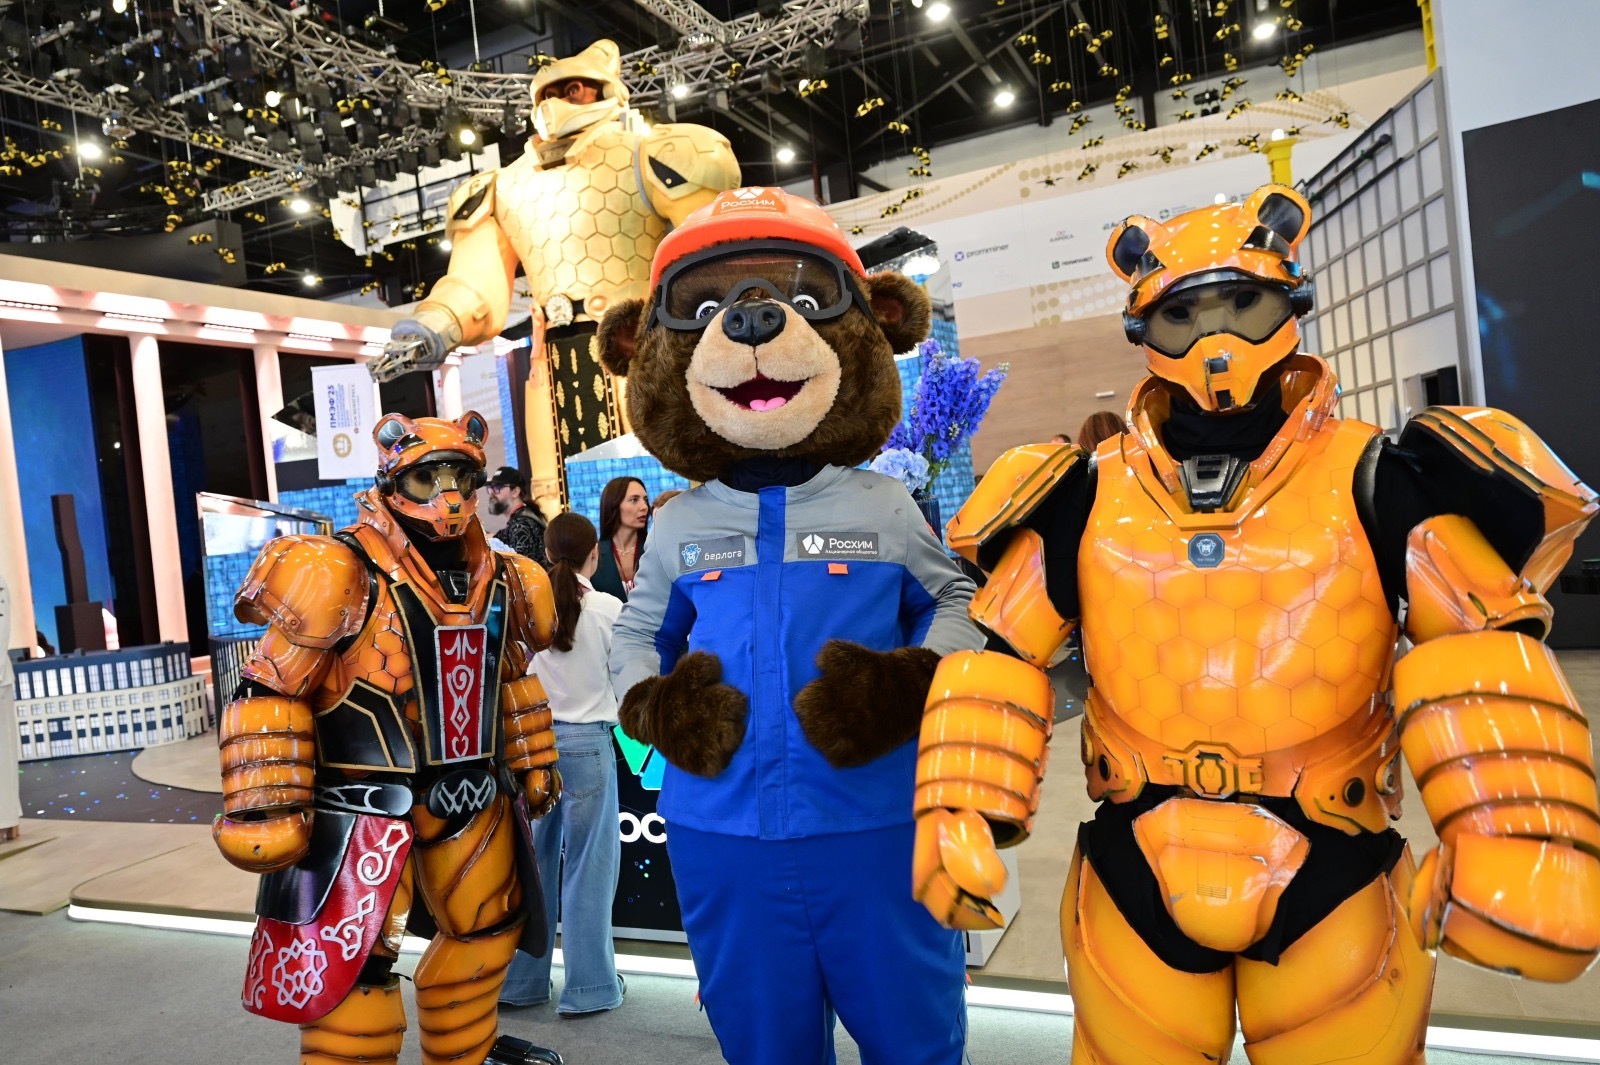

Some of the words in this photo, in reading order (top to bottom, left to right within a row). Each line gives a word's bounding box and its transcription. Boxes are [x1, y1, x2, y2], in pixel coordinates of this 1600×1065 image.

[966, 244, 1009, 258] promminer
[328, 384, 336, 428] ПМЭФ'25
[829, 538, 873, 549] Росхим
[704, 550, 742, 561] берлога
